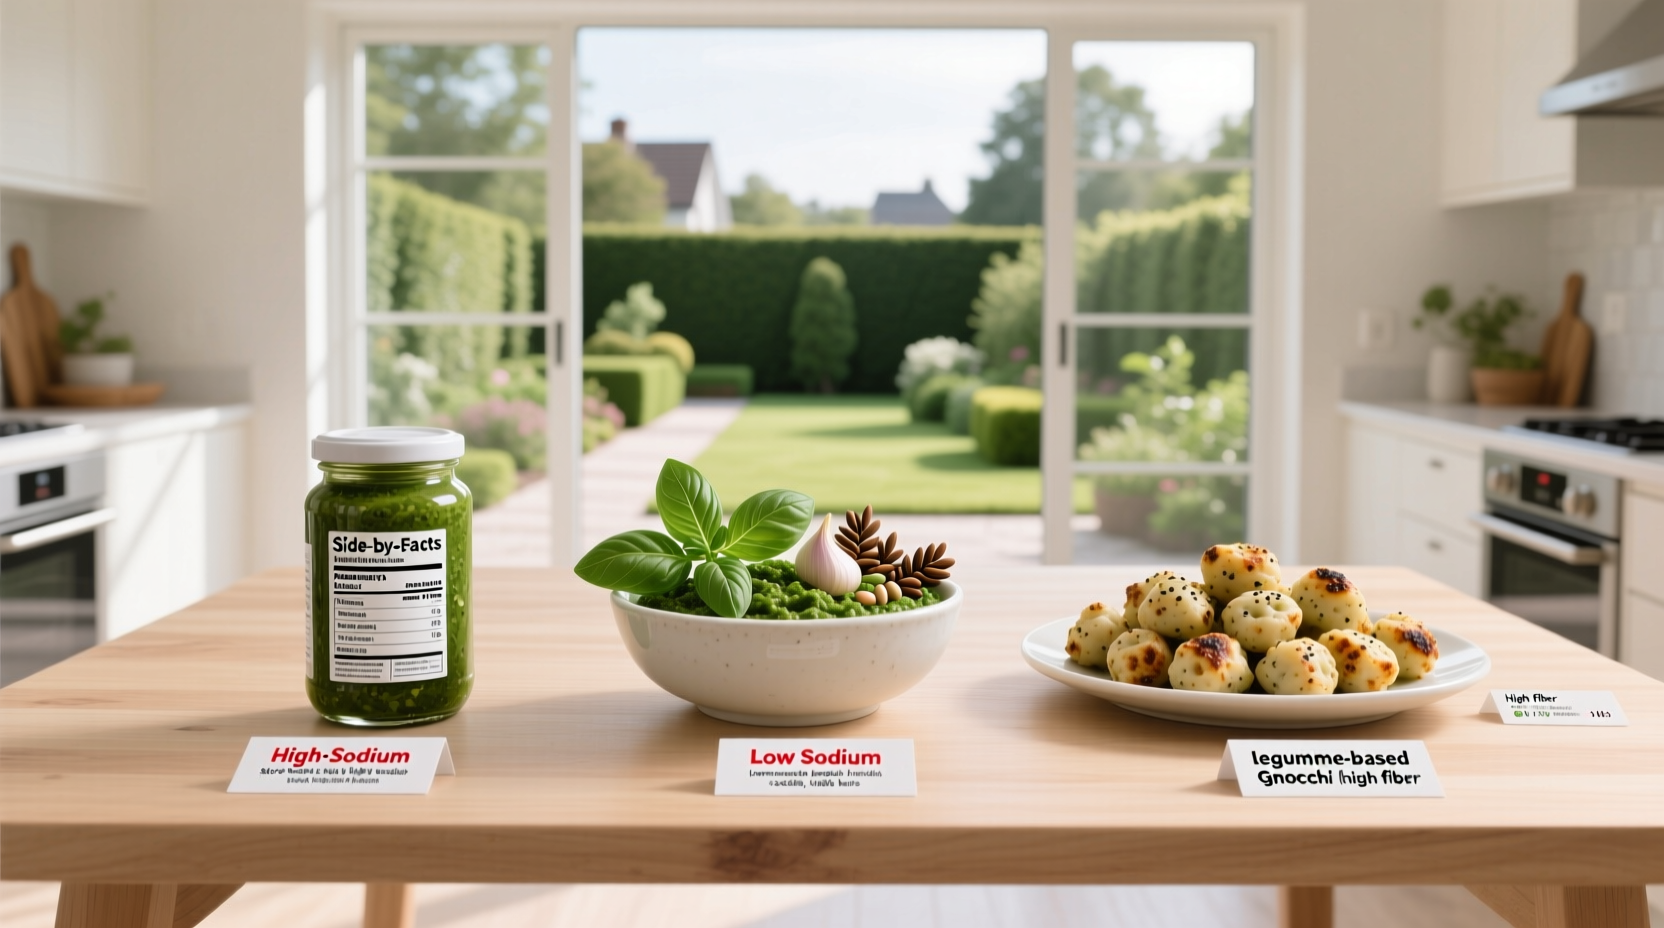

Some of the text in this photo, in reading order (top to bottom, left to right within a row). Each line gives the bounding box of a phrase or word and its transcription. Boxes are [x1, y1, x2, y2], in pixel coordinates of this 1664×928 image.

[332, 536, 442, 556] Side-by-Facts
[271, 748, 410, 767] High-Sodium
[750, 748, 881, 765] Low Sodium
[1251, 750, 1410, 769] legumme-based
[1257, 770, 1333, 787] Gnocchi
[1381, 769, 1421, 785] fiber
